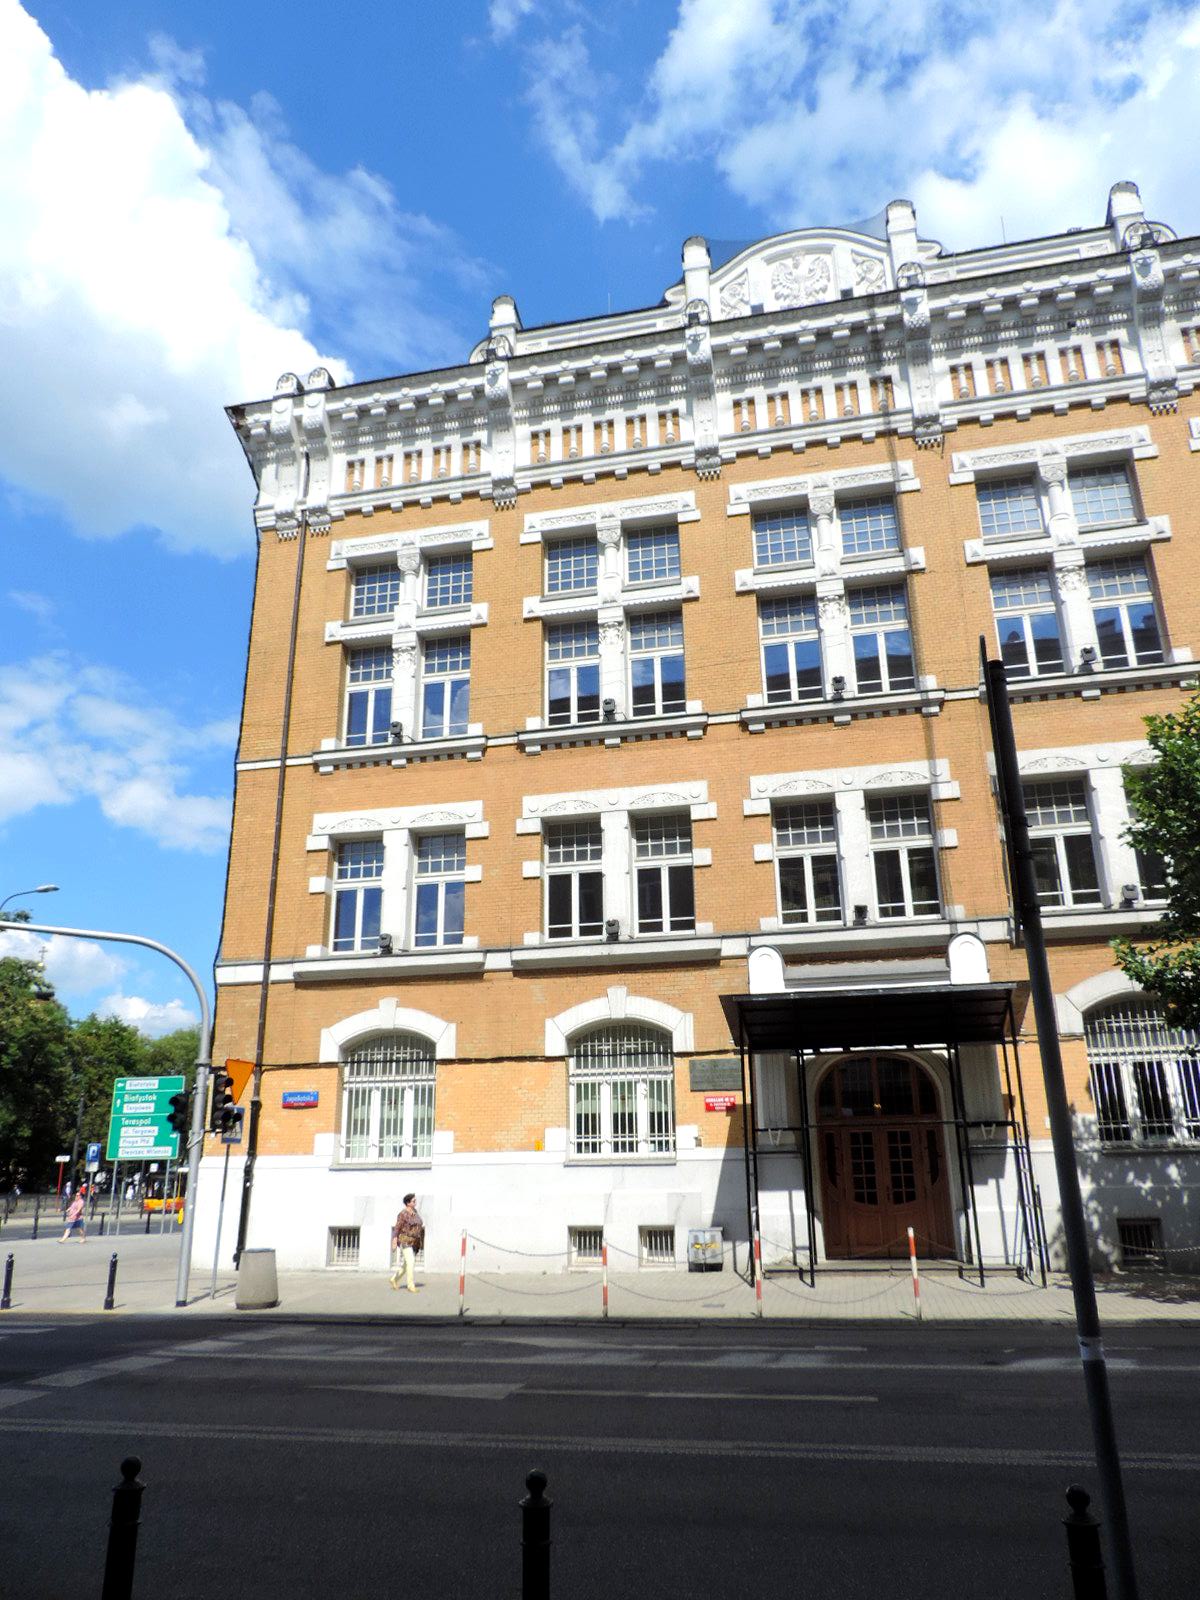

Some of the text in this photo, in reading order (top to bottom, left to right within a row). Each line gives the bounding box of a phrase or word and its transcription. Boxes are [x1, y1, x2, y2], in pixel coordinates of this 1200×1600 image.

[124, 1093, 157, 1103] Białystok
[121, 1117, 151, 1126] Terespol
[89, 1145, 98, 1160] P
